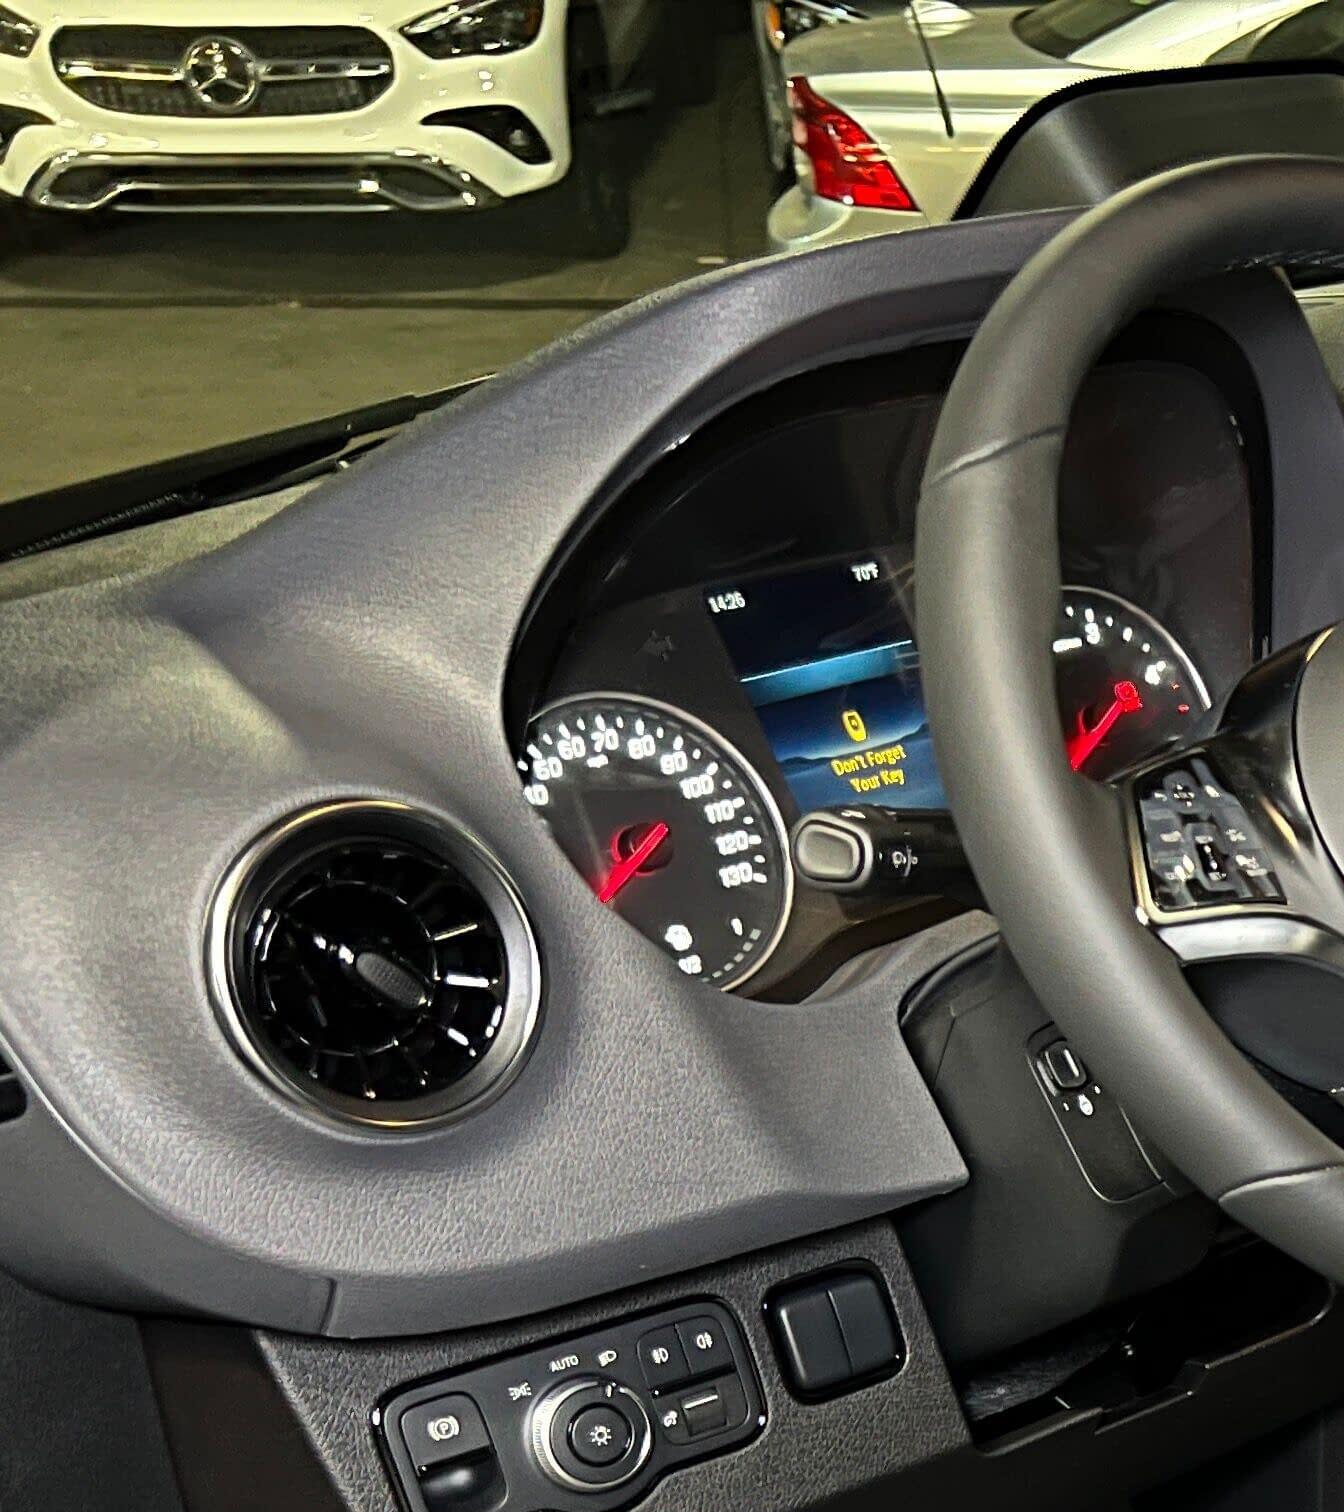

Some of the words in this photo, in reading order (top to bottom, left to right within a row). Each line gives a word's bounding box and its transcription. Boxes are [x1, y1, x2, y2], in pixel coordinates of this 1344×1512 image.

[557, 735, 586, 760] 60
[591, 728, 619, 752] 70
[628, 735, 656, 760] 80
[660, 751, 688, 775] 90
[831, 755, 868, 776] Don't
[866, 745, 906, 766] Forget
[680, 774, 714, 799] 100
[850, 776, 880, 792] Your
[880, 769, 904, 785] Key
[704, 800, 735, 824] 110
[716, 831, 749, 855] 120
[719, 862, 752, 888] 130
[549, 1354, 579, 1372] AUTO
